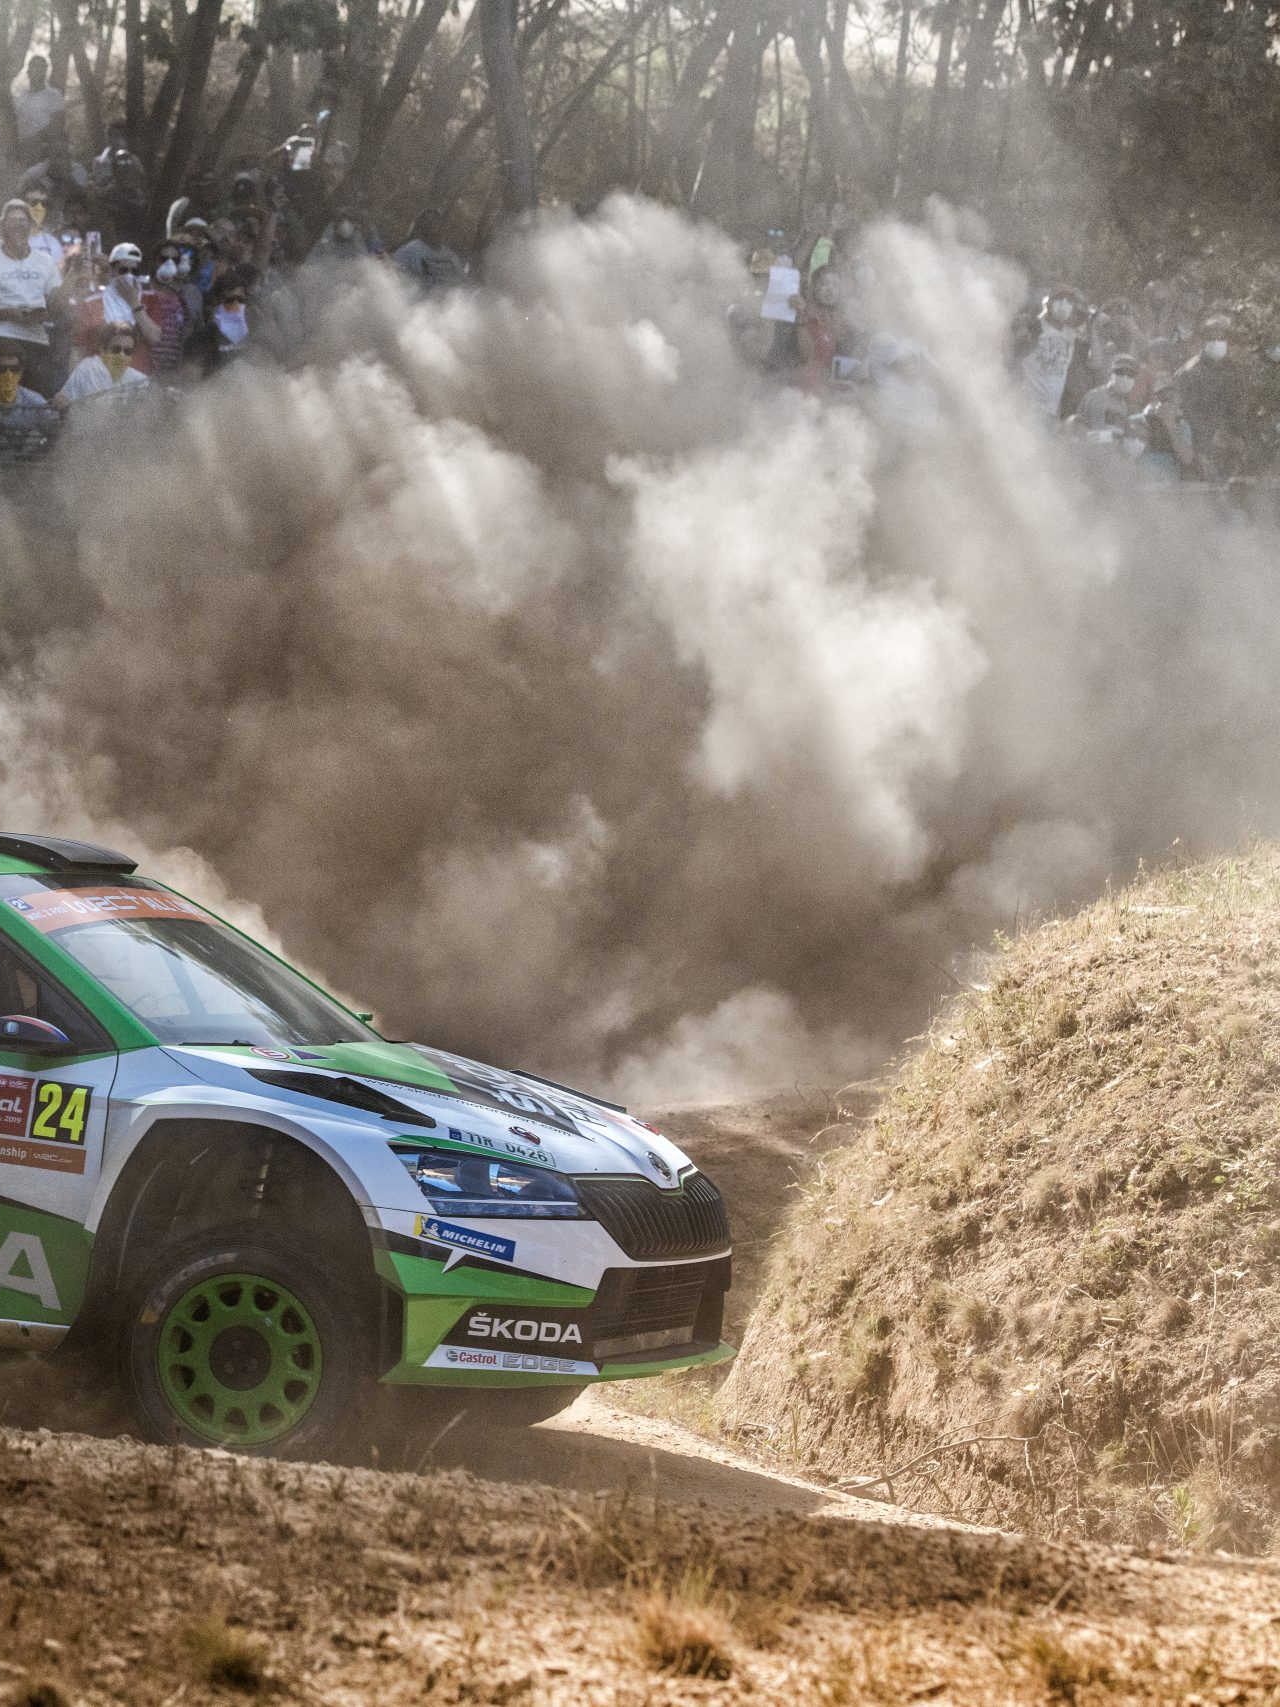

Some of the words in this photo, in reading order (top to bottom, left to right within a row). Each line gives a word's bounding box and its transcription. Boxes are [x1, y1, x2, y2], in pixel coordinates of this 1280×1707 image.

[3, 1115, 22, 1124] 2019
[32, 1083, 88, 1142] 24
[441, 1229, 508, 1254] MICHELIN
[467, 1311, 583, 1344] ŠKODA
[458, 1351, 498, 1365] Castrol
[502, 1353, 577, 1373] EDGE
